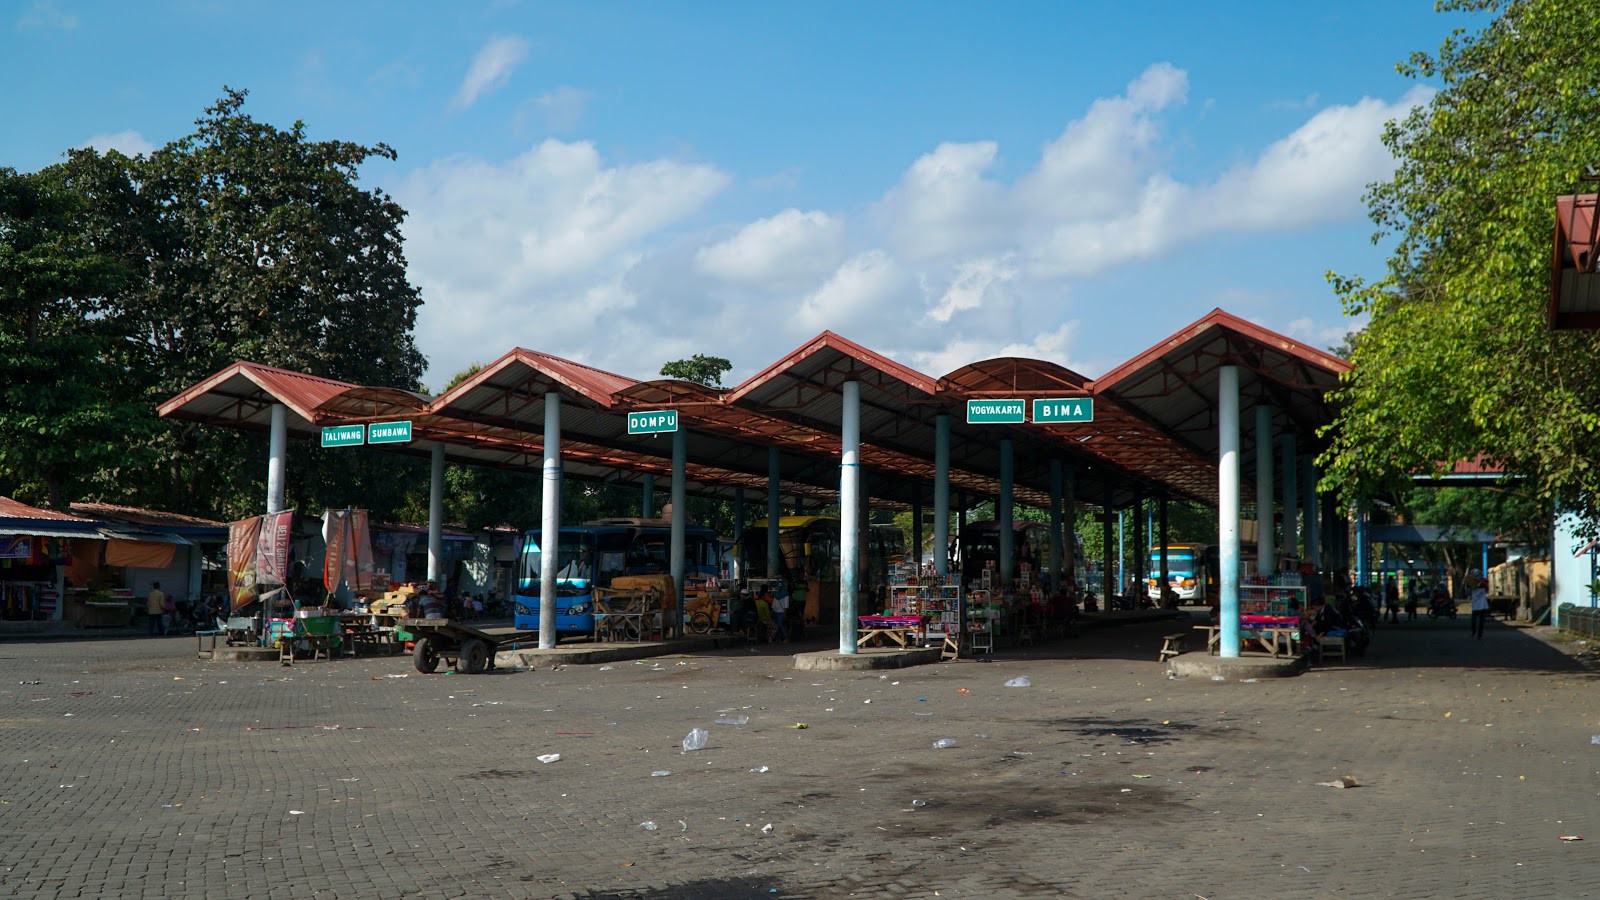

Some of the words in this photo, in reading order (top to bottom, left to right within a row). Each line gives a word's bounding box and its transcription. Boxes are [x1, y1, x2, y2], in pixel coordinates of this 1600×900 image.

[970, 405, 1022, 414] YOGYAKARTA
[1043, 405, 1083, 416] BIMA
[631, 415, 675, 429] DOMPU
[325, 431, 361, 441] TALIWANG
[372, 427, 408, 438] SUMBAWA
[277, 525, 287, 540] BELI
